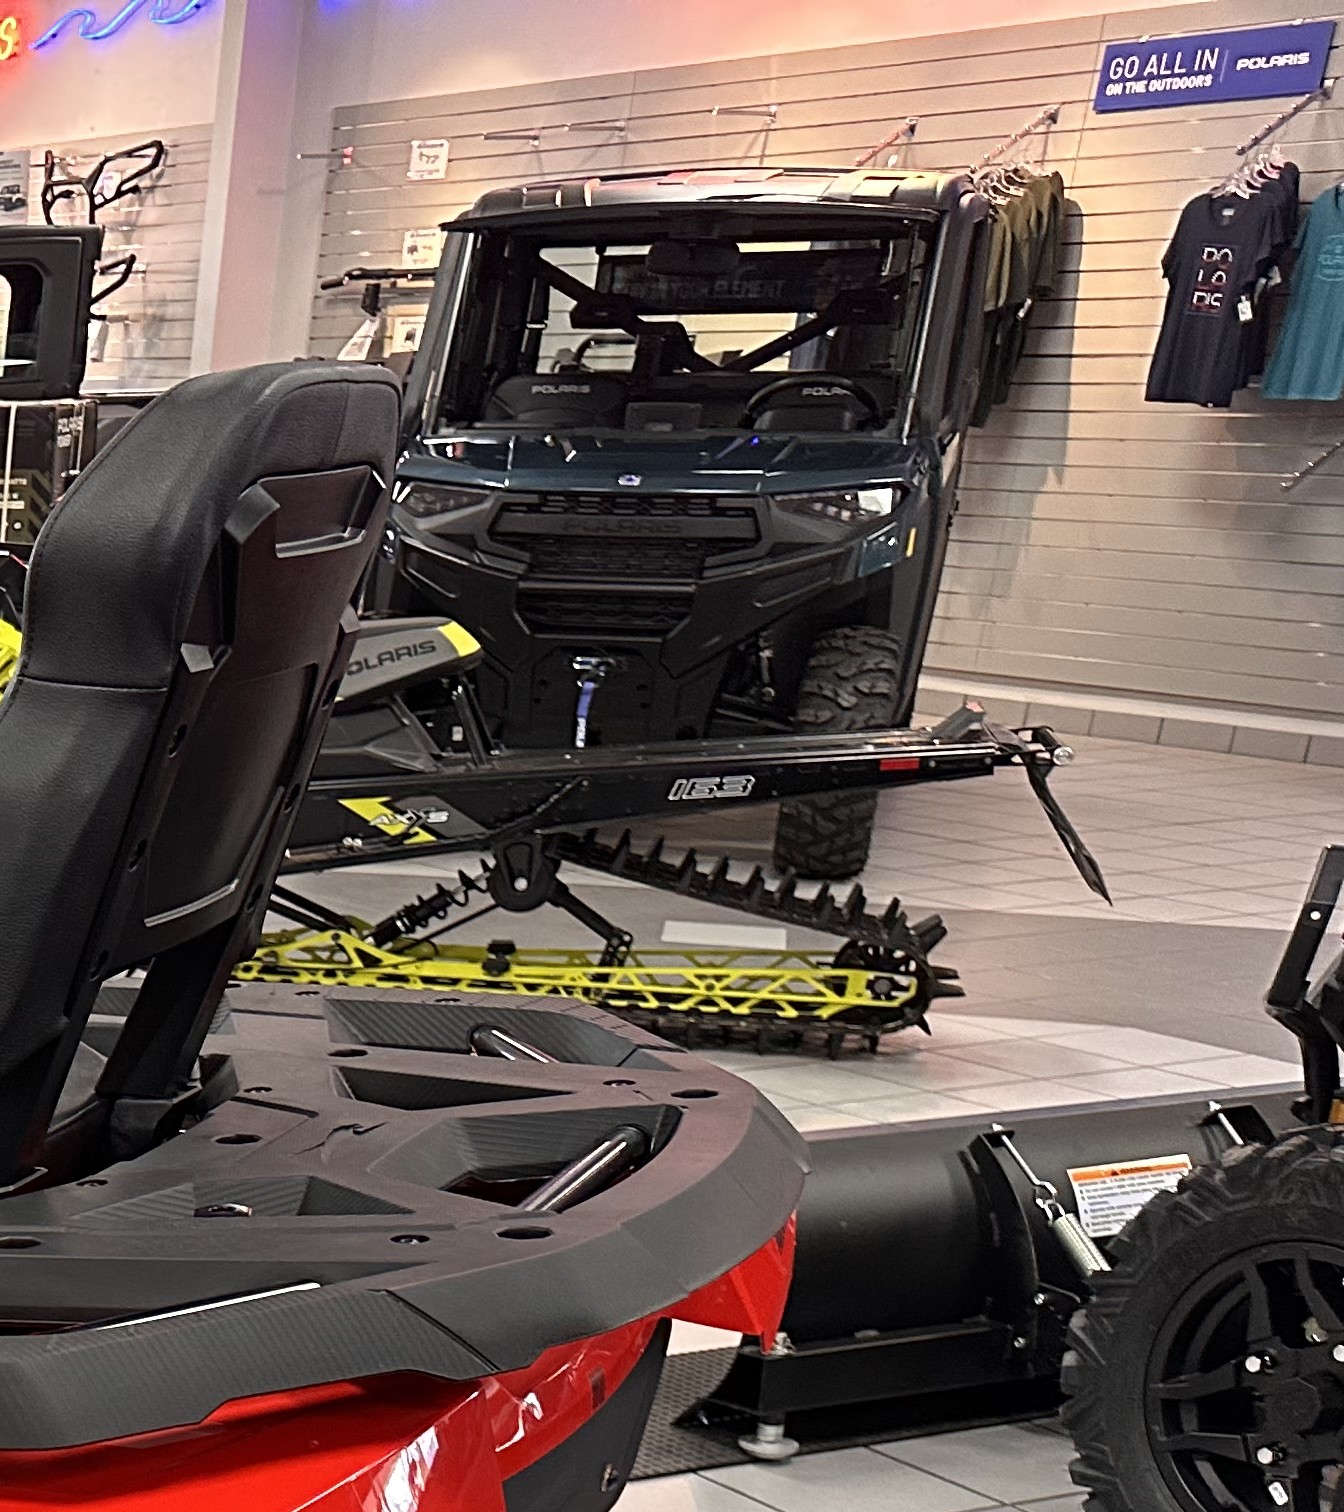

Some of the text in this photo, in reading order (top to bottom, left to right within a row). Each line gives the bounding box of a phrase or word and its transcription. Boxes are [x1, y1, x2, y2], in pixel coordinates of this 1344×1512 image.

[1109, 47, 1219, 80] GO ALL IN
[1236, 52, 1310, 71] POLARIS
[1105, 74, 1213, 96] ON THE OUTDOORS
[531, 384, 591, 395] POLARIS
[347, 639, 437, 676] OLARIS
